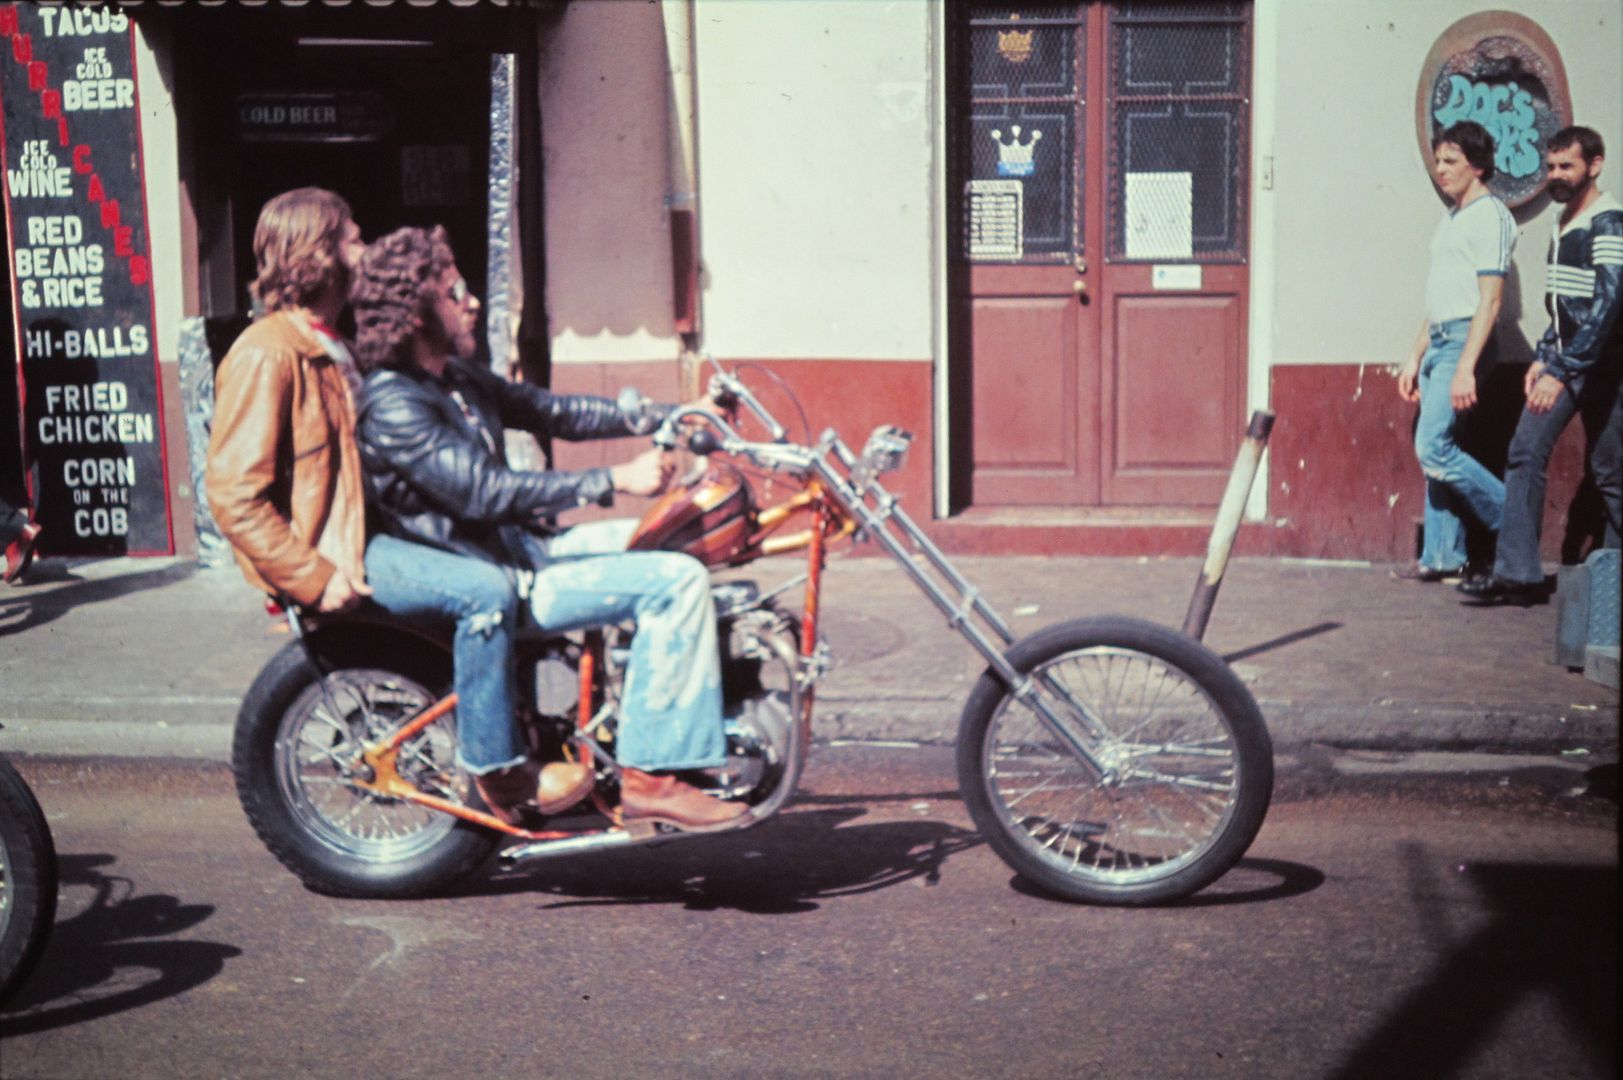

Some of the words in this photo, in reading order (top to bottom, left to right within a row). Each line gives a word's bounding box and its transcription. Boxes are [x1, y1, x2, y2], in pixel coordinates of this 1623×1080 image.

[38, 6, 129, 37] TACOS
[76, 62, 112, 79] COLD
[83, 47, 107, 63] ICE
[63, 78, 134, 111] BEER
[240, 105, 285, 123] COLD
[290, 105, 337, 123] BEER
[0, 5, 148, 285] HURRICANES
[23, 140, 49, 156] ICE
[20, 154, 57, 171] COLD
[7, 167, 73, 198] WINE
[28, 215, 83, 246] RED
[15, 244, 104, 278] BEANS
[22, 279, 40, 308] &
[43, 277, 103, 307] RICE
[26, 324, 149, 359] HI-BALLS
[45, 382, 128, 413] FRIED
[38, 413, 154, 444] CHICKEN
[63, 456, 136, 488] CORN
[73, 488, 90, 504] ON
[101, 487, 128, 504] THE
[74, 506, 129, 538] COB
